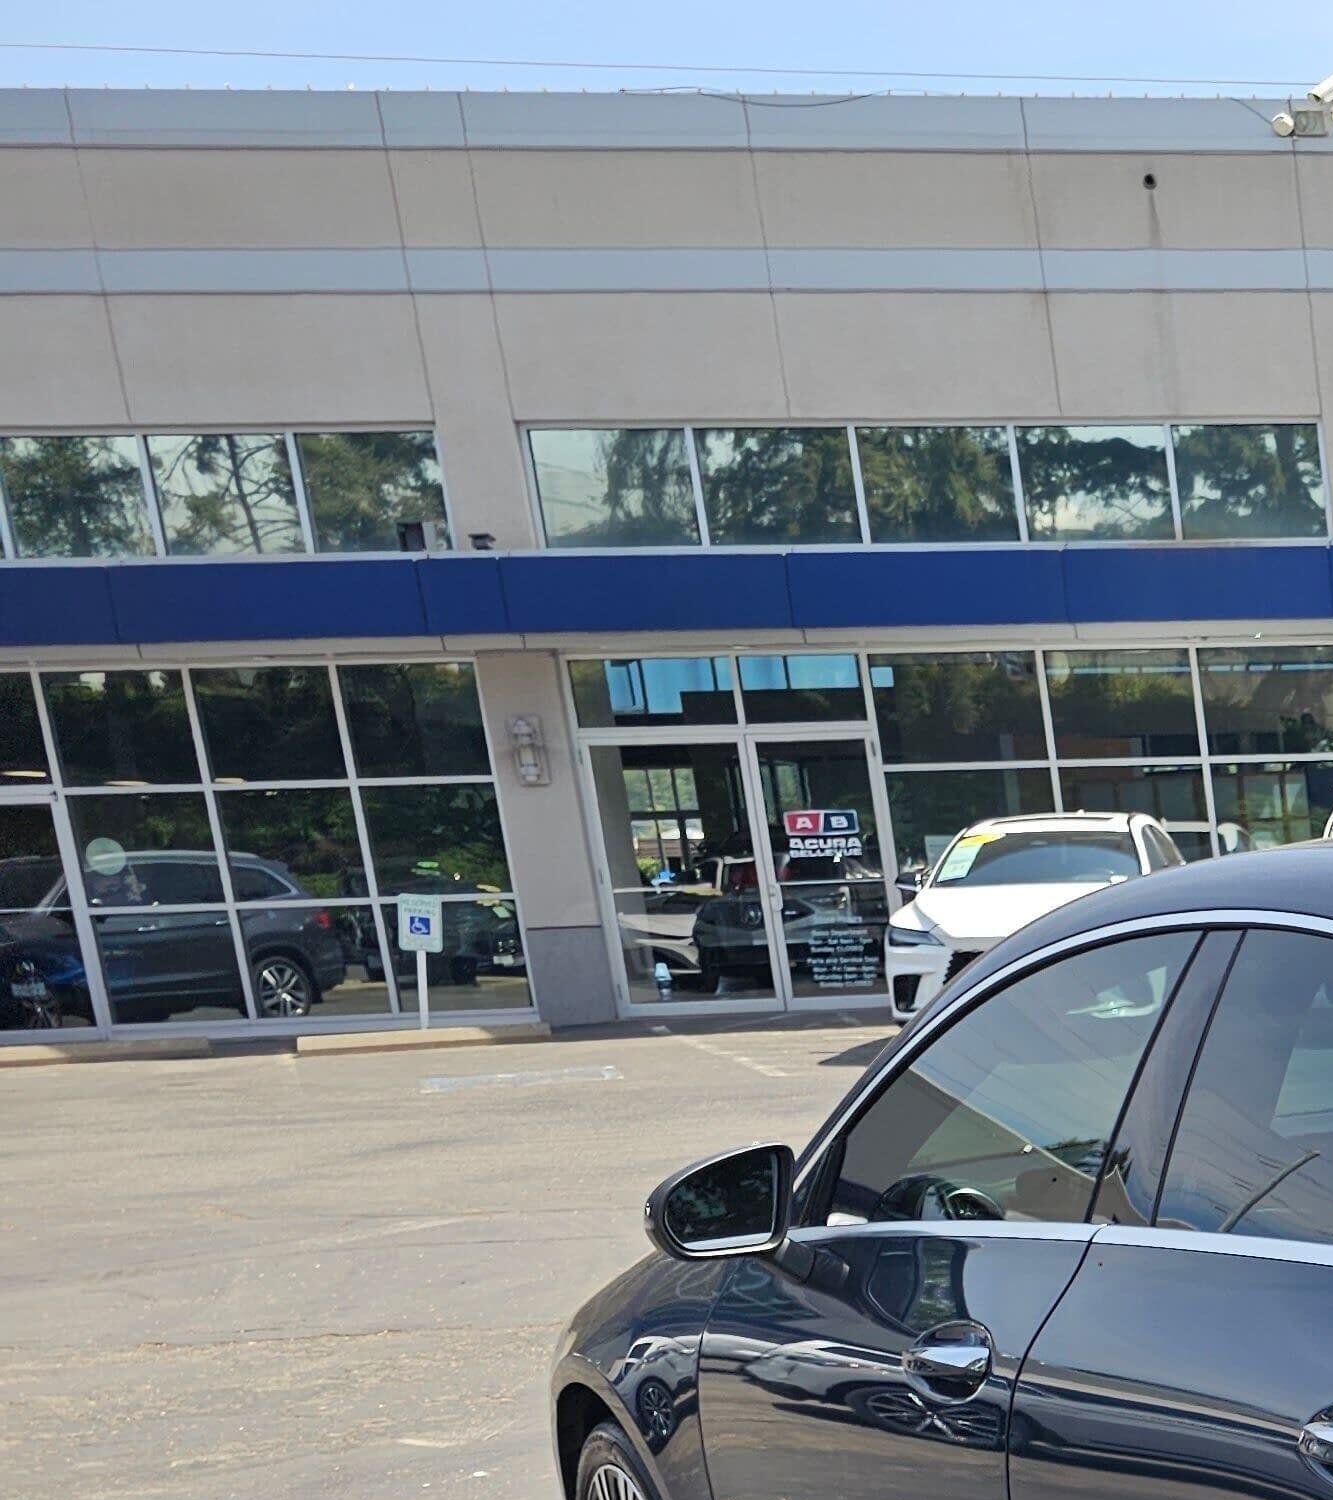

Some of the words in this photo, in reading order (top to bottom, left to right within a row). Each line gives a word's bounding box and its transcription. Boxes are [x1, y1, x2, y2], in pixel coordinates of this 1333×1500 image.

[796, 816, 813, 830] A
[830, 815, 848, 829] B
[789, 837, 862, 849] ACURA
[789, 848, 862, 858] BELLEVUE
